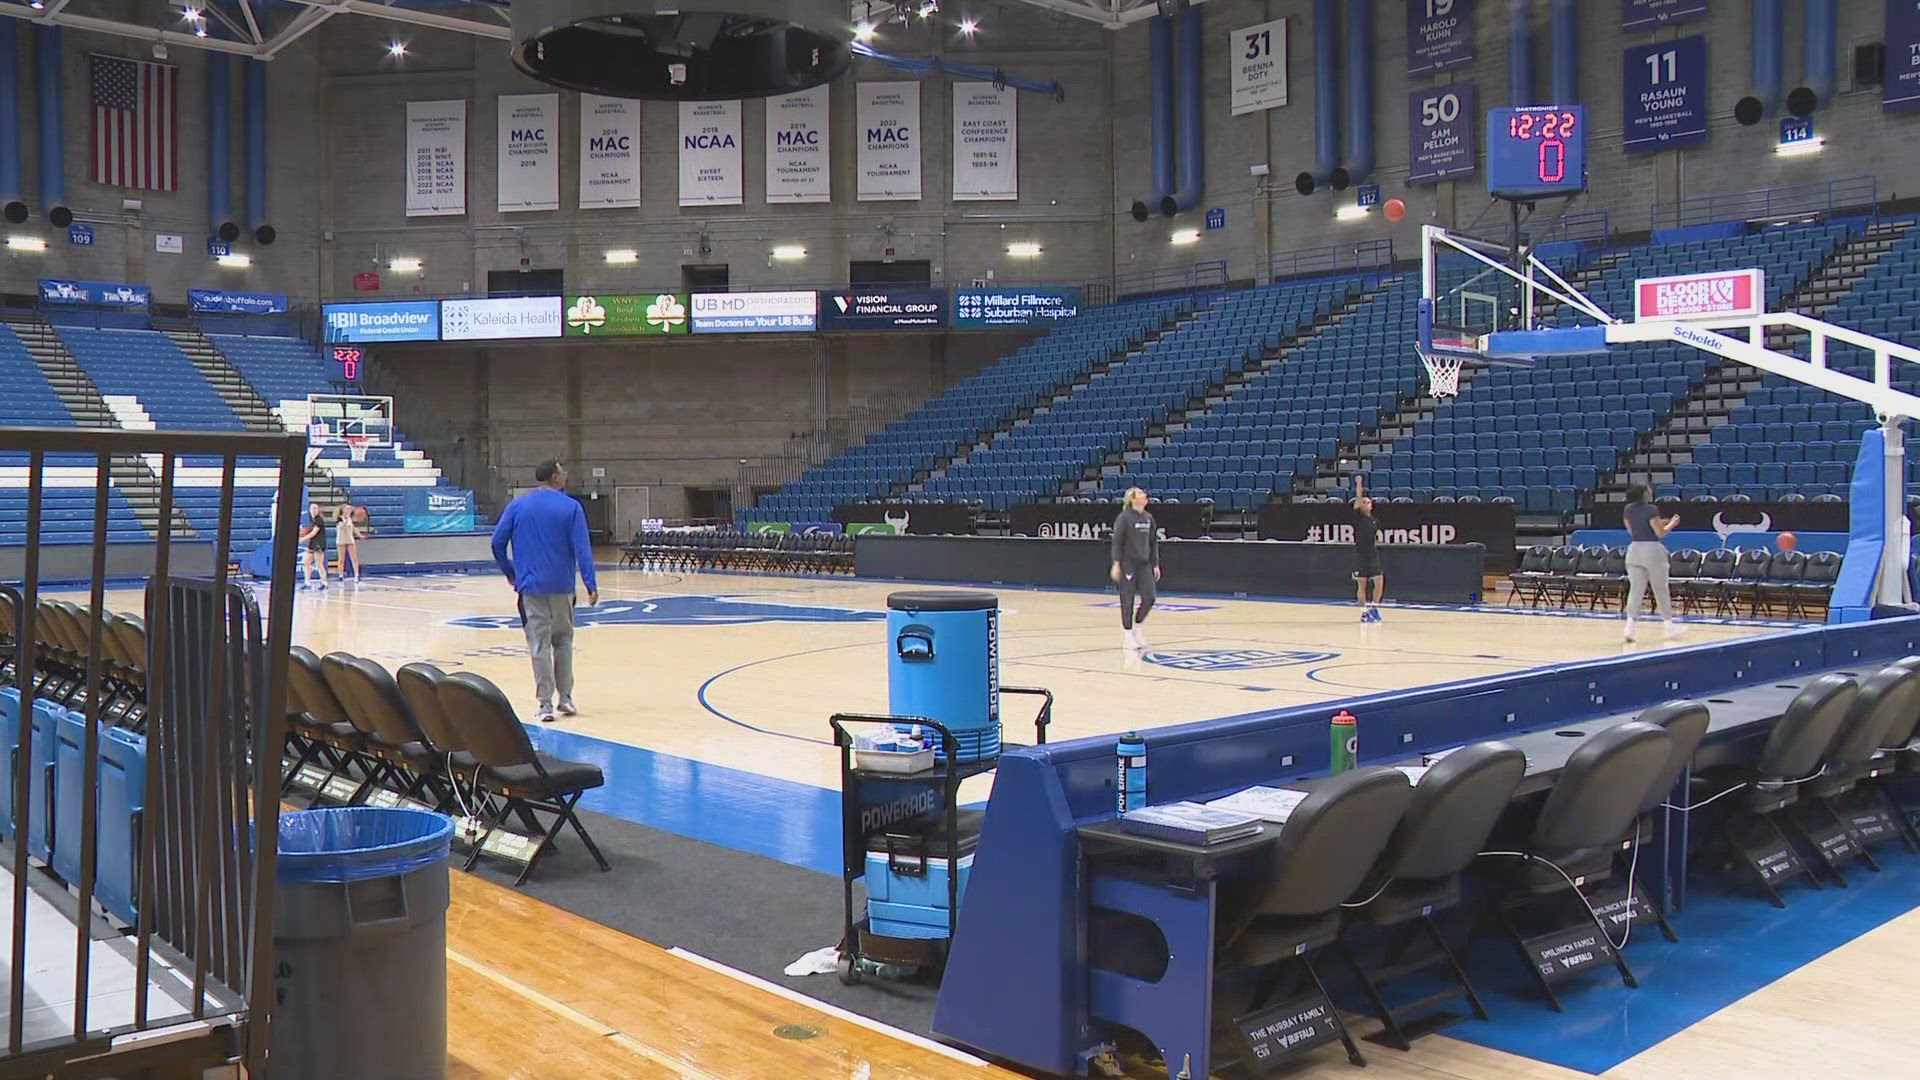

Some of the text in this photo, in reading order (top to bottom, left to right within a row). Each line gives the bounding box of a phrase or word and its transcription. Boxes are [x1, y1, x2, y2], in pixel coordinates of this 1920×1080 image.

[1420, 18, 1457, 34] HAROLD
[1426, 29, 1451, 41] KUHN
[1245, 30, 1270, 60] 31
[1242, 61, 1274, 74] BRENNA
[1645, 50, 1676, 85] 11
[1248, 71, 1268, 81] DOTY
[1640, 86, 1686, 103] RASAUN
[1421, 93, 1460, 127] 50
[1644, 97, 1683, 112] YOUNG
[1634, 116, 1653, 124] MEN'S
[1653, 110, 1693, 121] BASKETBALL
[1511, 112, 1575, 139] 12:22
[511, 129, 544, 142] MAC
[777, 131, 818, 145] MAC
[867, 128, 909, 142] MAC
[1431, 128, 1451, 140] SAM
[1785, 127, 1807, 141] 114
[590, 136, 630, 151] MAC
[685, 135, 735, 149] NCAA
[1423, 136, 1459, 151] PELLOM
[1434, 149, 1464, 159] BASKETBALL
[1539, 139, 1564, 182] 0
[1361, 194, 1375, 205] 112
[1209, 218, 1222, 228] 111
[72, 235, 90, 244] 109
[211, 246, 226, 255] 110
[1656, 280, 1710, 297] FLOOR
[856, 295, 887, 304] VISION
[984, 294, 1062, 306] Millard Fillmore
[856, 304, 938, 314] FINANCIAL GROUP
[984, 306, 1077, 320] Suburban Hospital
[1657, 303, 1734, 316] TILE WOOD STONE
[360, 312, 430, 325] Broadview
[473, 310, 560, 325] Kaleida Health
[694, 315, 813, 328] Team Doctors for Your UB Bulls
[360, 327, 381, 335] Federal
[1673, 326, 1723, 350] Schelde
[333, 349, 360, 361] 12:22
[344, 361, 356, 379] 0
[988, 617, 998, 718] POWERADE
[861, 788, 935, 833] POWERADE
[1573, 936, 1596, 950] FAMILY
[1568, 951, 1593, 966] BUFFALO
[1250, 1028, 1268, 1041] THE
[1266, 1017, 1299, 1036] MURRAY
[1298, 1005, 1326, 1024] FAMILY
[1287, 1026, 1316, 1045] BUFFALO
